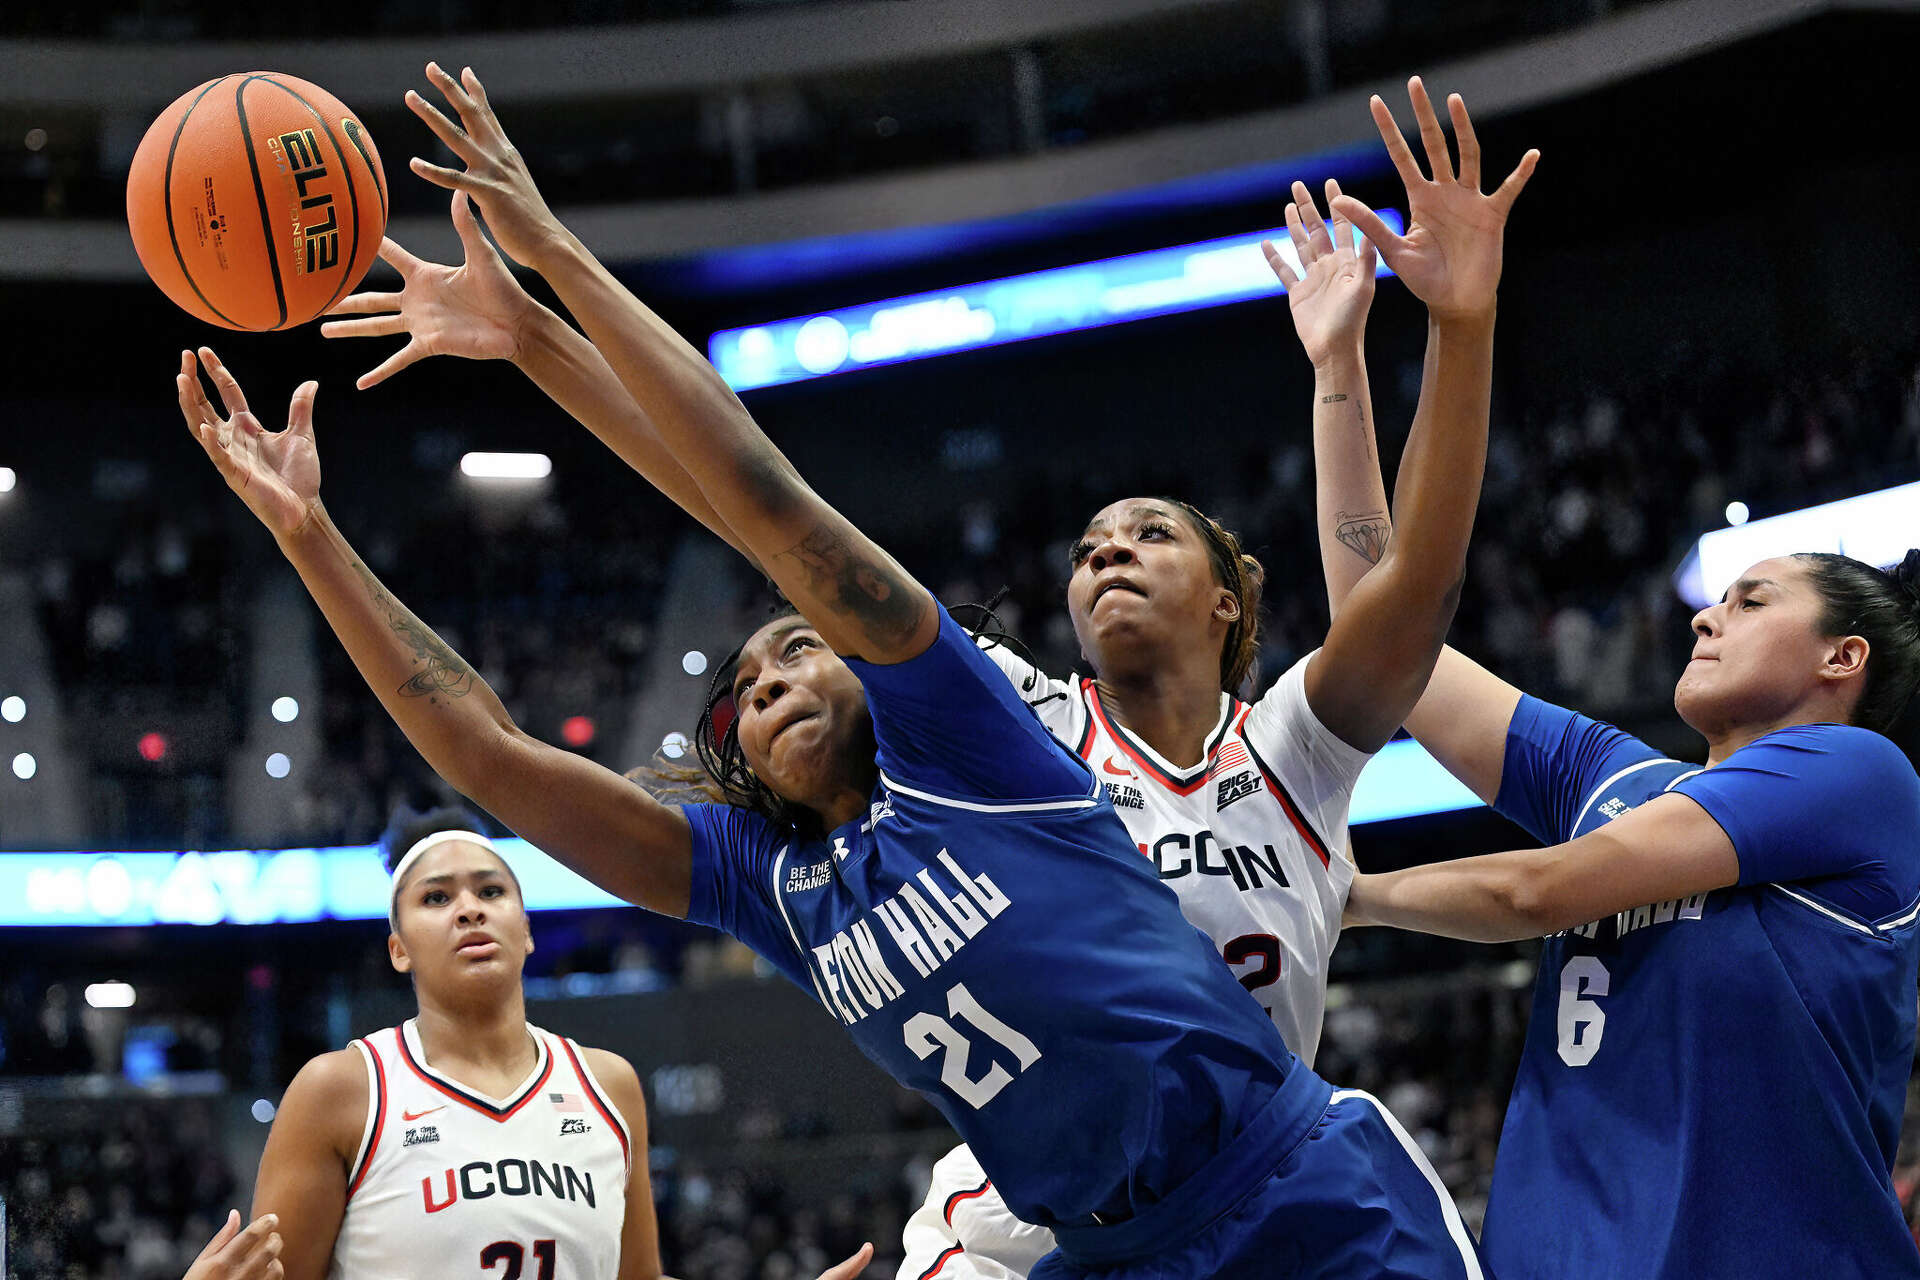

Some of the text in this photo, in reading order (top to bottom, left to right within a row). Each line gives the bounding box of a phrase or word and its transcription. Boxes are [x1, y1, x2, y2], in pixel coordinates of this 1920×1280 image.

[266, 137, 304, 277] CHAIONSHIP
[278, 128, 339, 274] ELITE
[1106, 783, 1143, 799] BE THE
[1109, 793, 1145, 810] HANGE
[1217, 776, 1262, 806] EAST
[1218, 770, 1250, 793] BIG
[786, 871, 831, 893] CHANGE
[790, 860, 830, 880] BE THE
[811, 847, 1012, 1026] ETON HALL
[1557, 955, 1610, 1067] 6
[903, 982, 1042, 1110] 21
[422, 1158, 596, 1214] UCONN
[480, 1239, 556, 1280] 21
